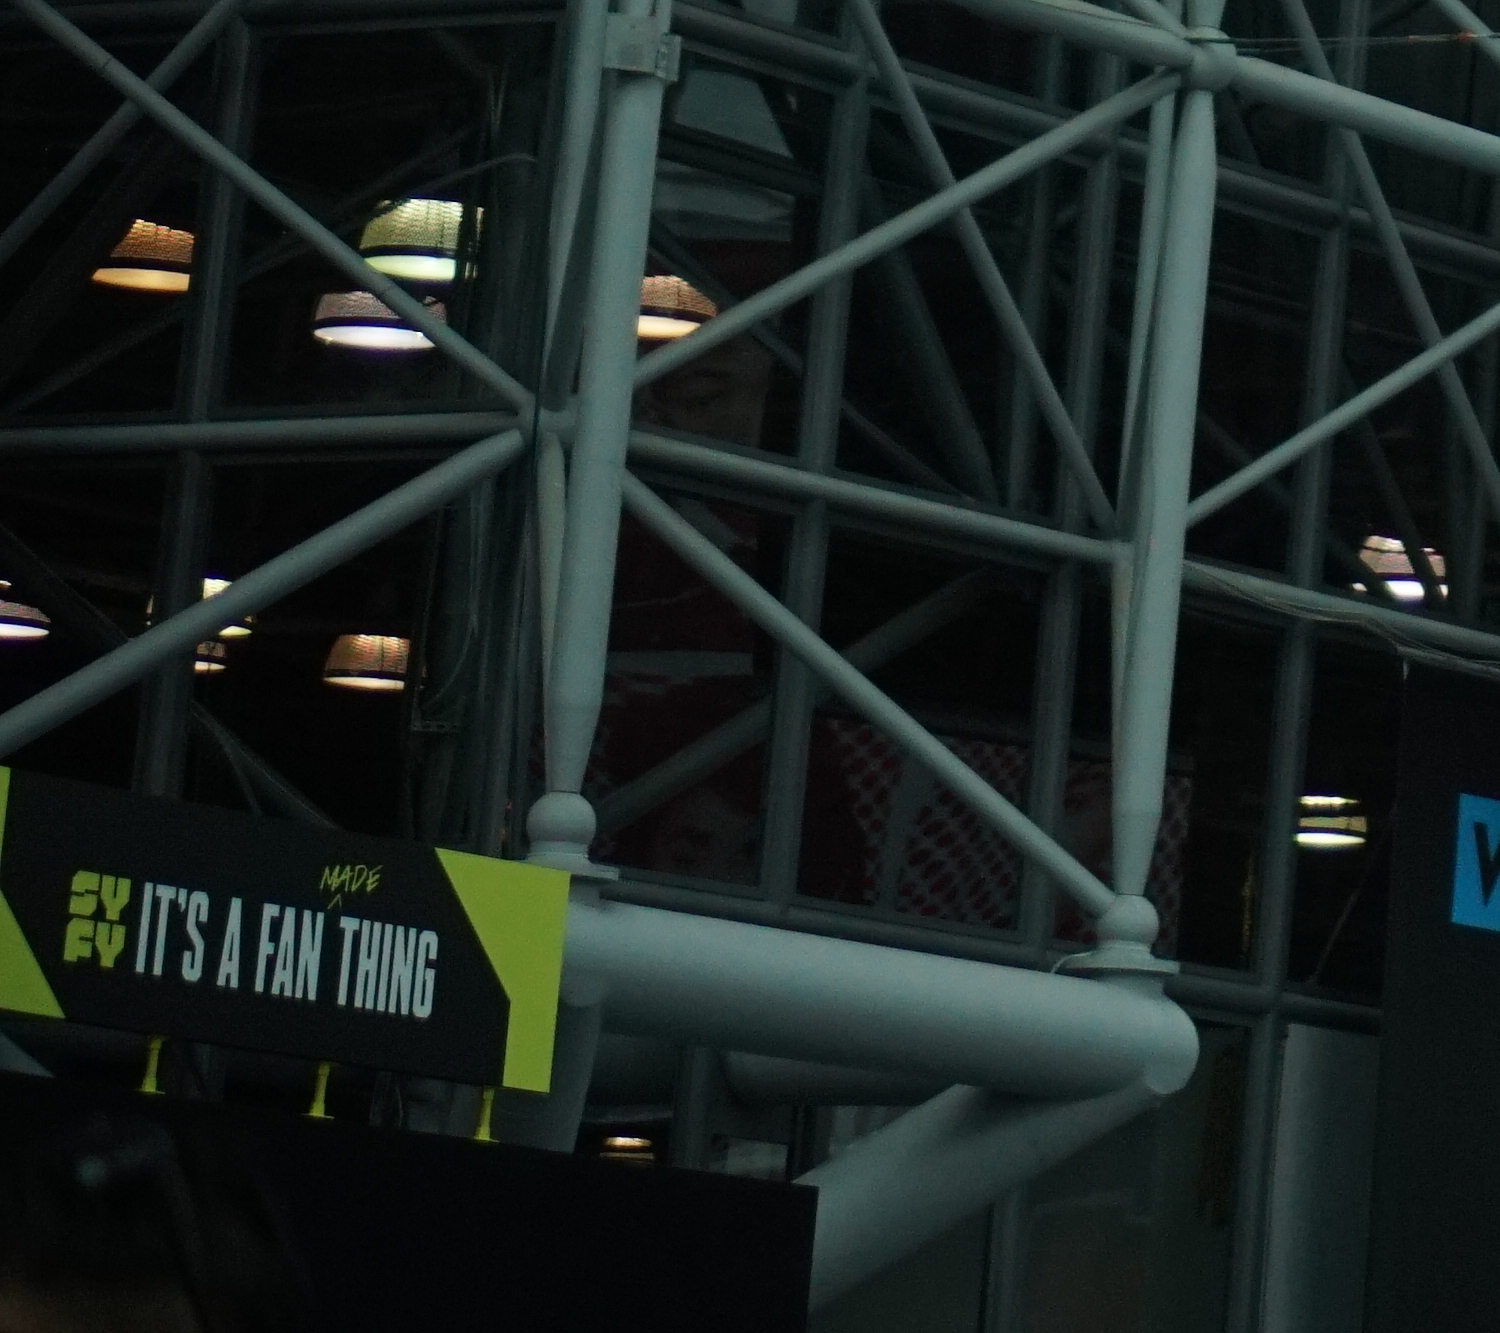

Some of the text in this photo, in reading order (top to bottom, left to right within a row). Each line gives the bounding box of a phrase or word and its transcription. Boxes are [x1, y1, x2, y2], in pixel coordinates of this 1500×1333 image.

[319, 864, 384, 893] MADE
[135, 881, 440, 1020] IT'S A FAN THING
